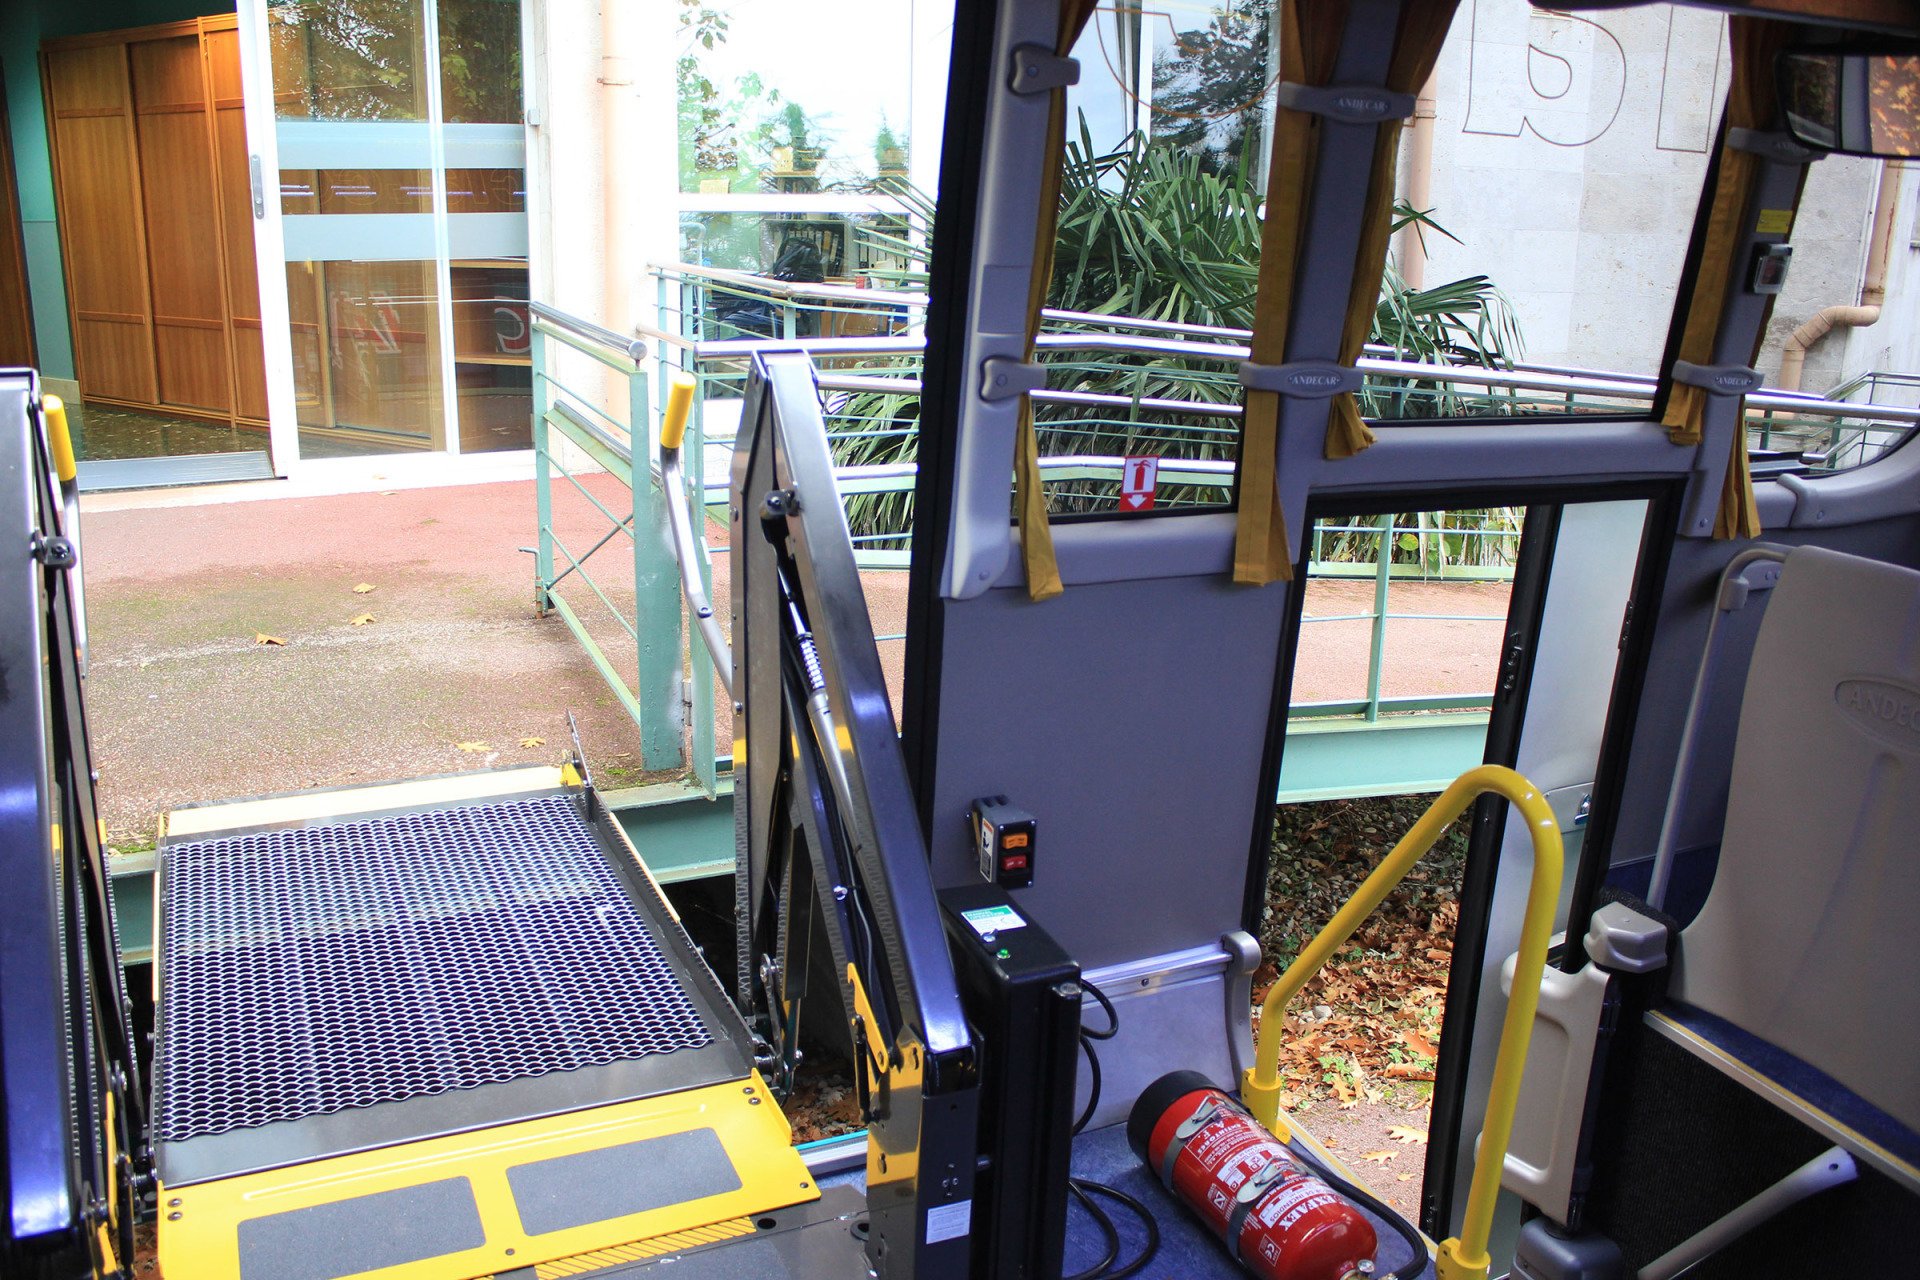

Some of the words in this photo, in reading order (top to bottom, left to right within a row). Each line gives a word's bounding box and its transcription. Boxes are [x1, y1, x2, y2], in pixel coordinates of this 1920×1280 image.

[1338, 97, 1385, 112] ANDECAR
[1291, 375, 1337, 385] ANDECAR
[1265, 1243, 1275, 1260] CE
